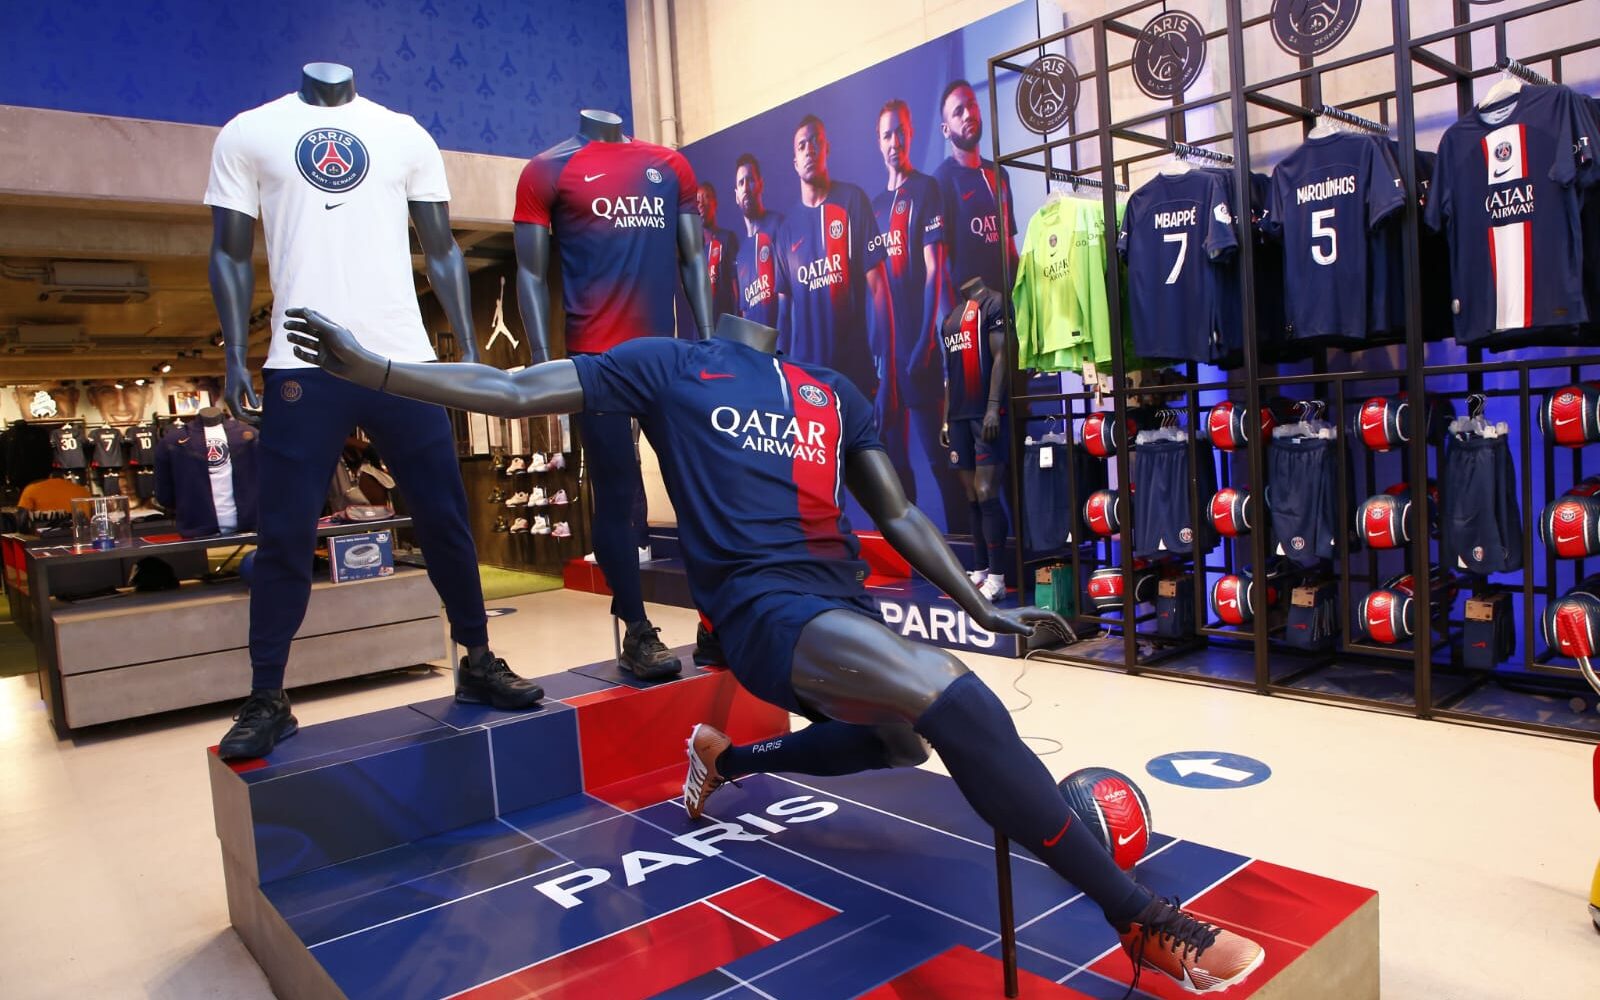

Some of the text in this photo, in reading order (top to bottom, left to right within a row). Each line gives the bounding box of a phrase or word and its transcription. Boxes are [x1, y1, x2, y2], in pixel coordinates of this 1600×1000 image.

[1148, 18, 1189, 36] ARIS
[1026, 60, 1065, 84] PRIS
[308, 131, 354, 146] PARIS
[591, 195, 665, 220] QATAR
[1154, 206, 1197, 230] MBAPPÉ
[614, 215, 666, 229] AIRWAYS
[1311, 208, 1337, 266] 5
[797, 253, 842, 285] QATAR
[1163, 232, 1188, 284] 7
[744, 274, 770, 303] QATAR
[808, 271, 843, 292] AIRWAYS
[944, 330, 971, 349] QATAR
[711, 406, 826, 449] QATAR
[61, 438, 77, 451] 30
[104, 439, 113, 452] 7
[140, 438, 152, 450] 10
[742, 435, 826, 465] AIRWAYS
[880, 601, 996, 648] PARIS
[752, 740, 783, 754] PARIS
[533, 795, 839, 909] PARIS
